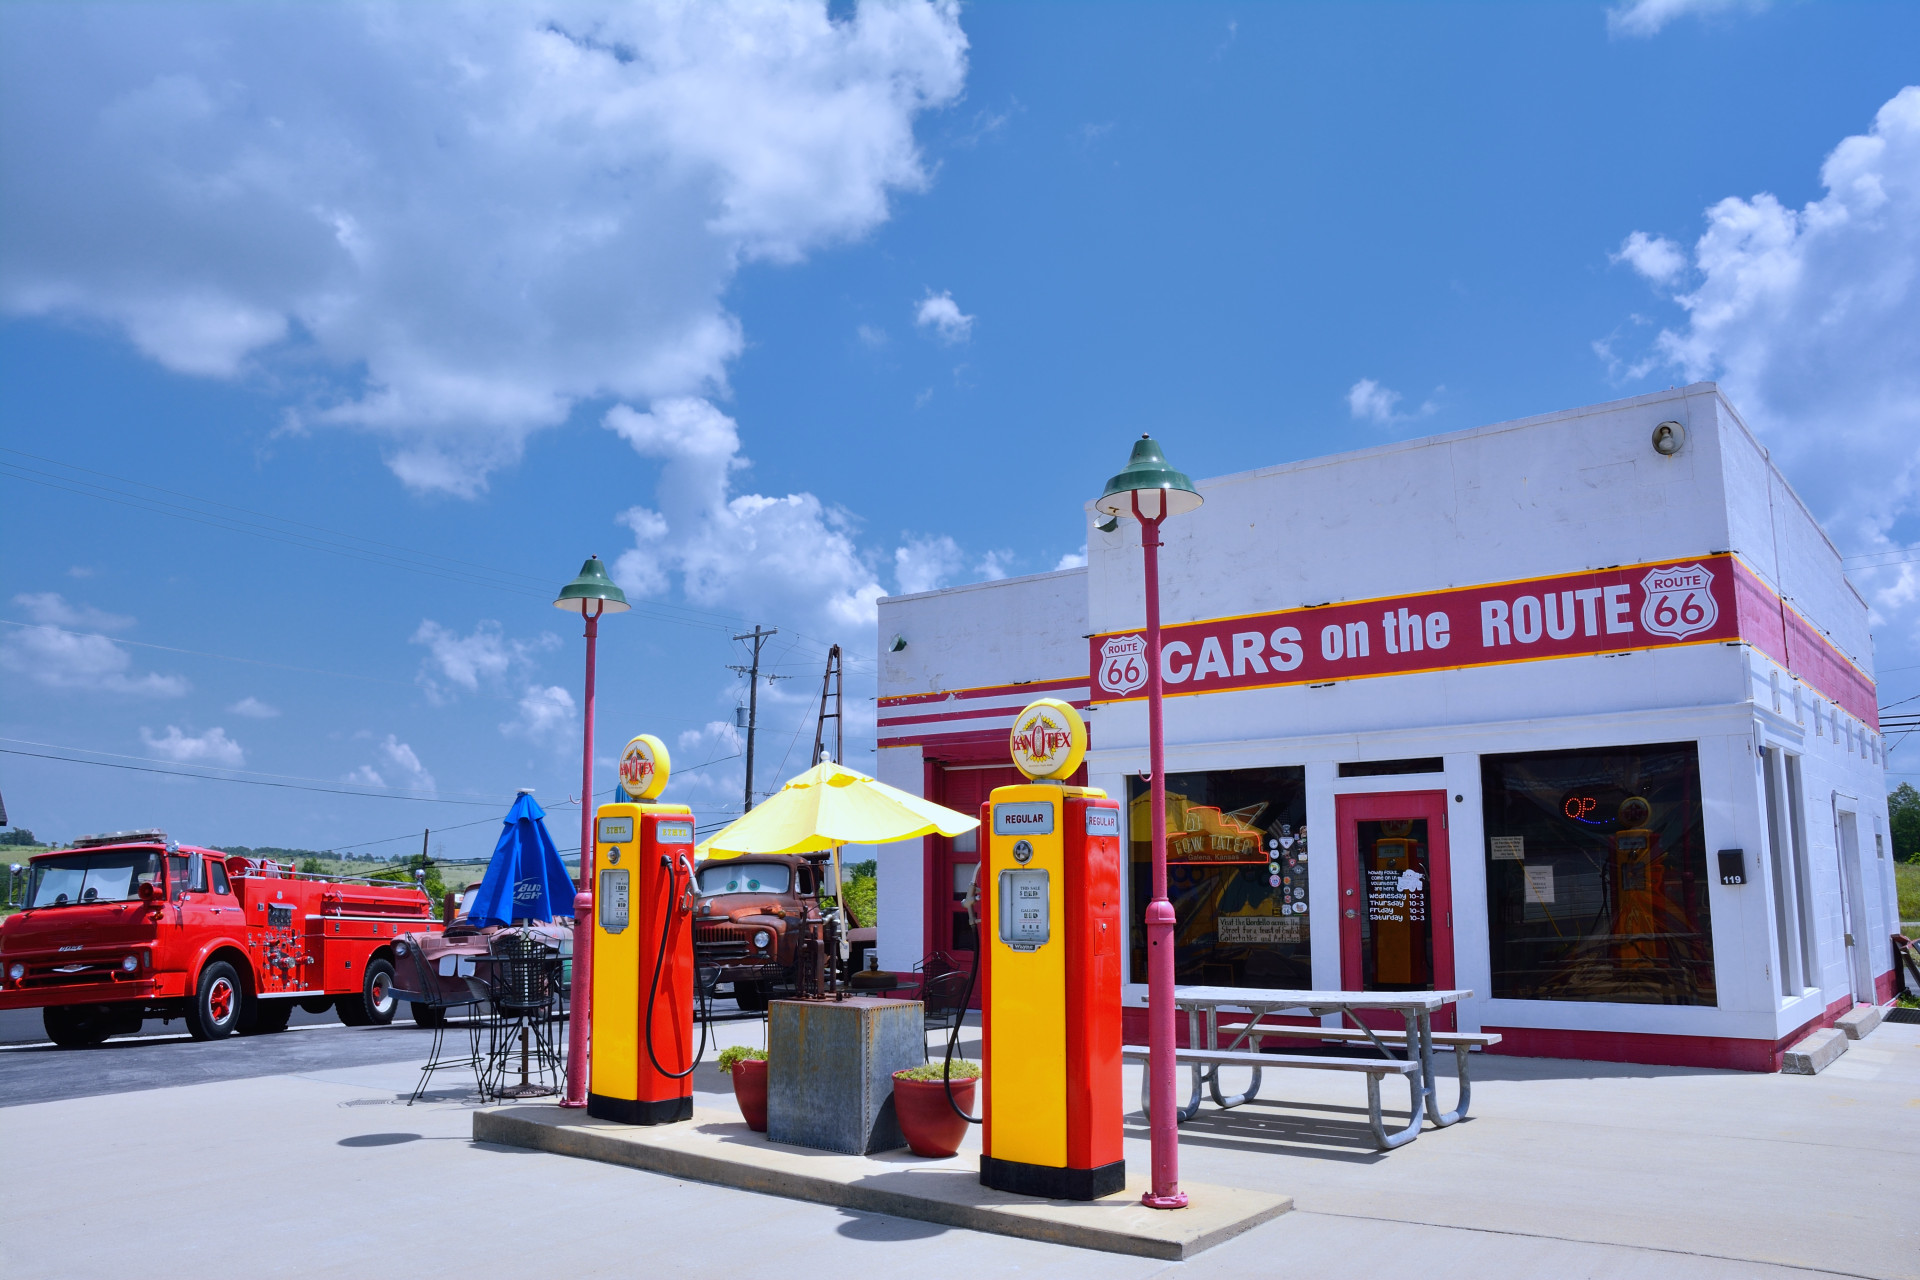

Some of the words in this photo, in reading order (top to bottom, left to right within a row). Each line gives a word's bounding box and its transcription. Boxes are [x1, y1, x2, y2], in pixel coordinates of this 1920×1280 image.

[1654, 574, 1701, 589] ROUTE
[1653, 592, 1704, 627] 66
[1160, 626, 1304, 684] CARS
[1321, 620, 1370, 661] on
[1382, 607, 1451, 655] the
[1480, 583, 1634, 647] ROUTE
[1108, 642, 1138, 655] ROUTE
[1107, 656, 1140, 686] 66
[1005, 813, 1044, 825] REGULAR
[1088, 816, 1115, 827] REGULAR
[606, 826, 626, 835] ETHYL
[662, 828, 688, 837] ETHYL
[1172, 836, 1203, 855] TOW
[1724, 875, 1741, 884] 119
[518, 883, 542, 892] BUD
[1246, 918, 1270, 926] Bordello
